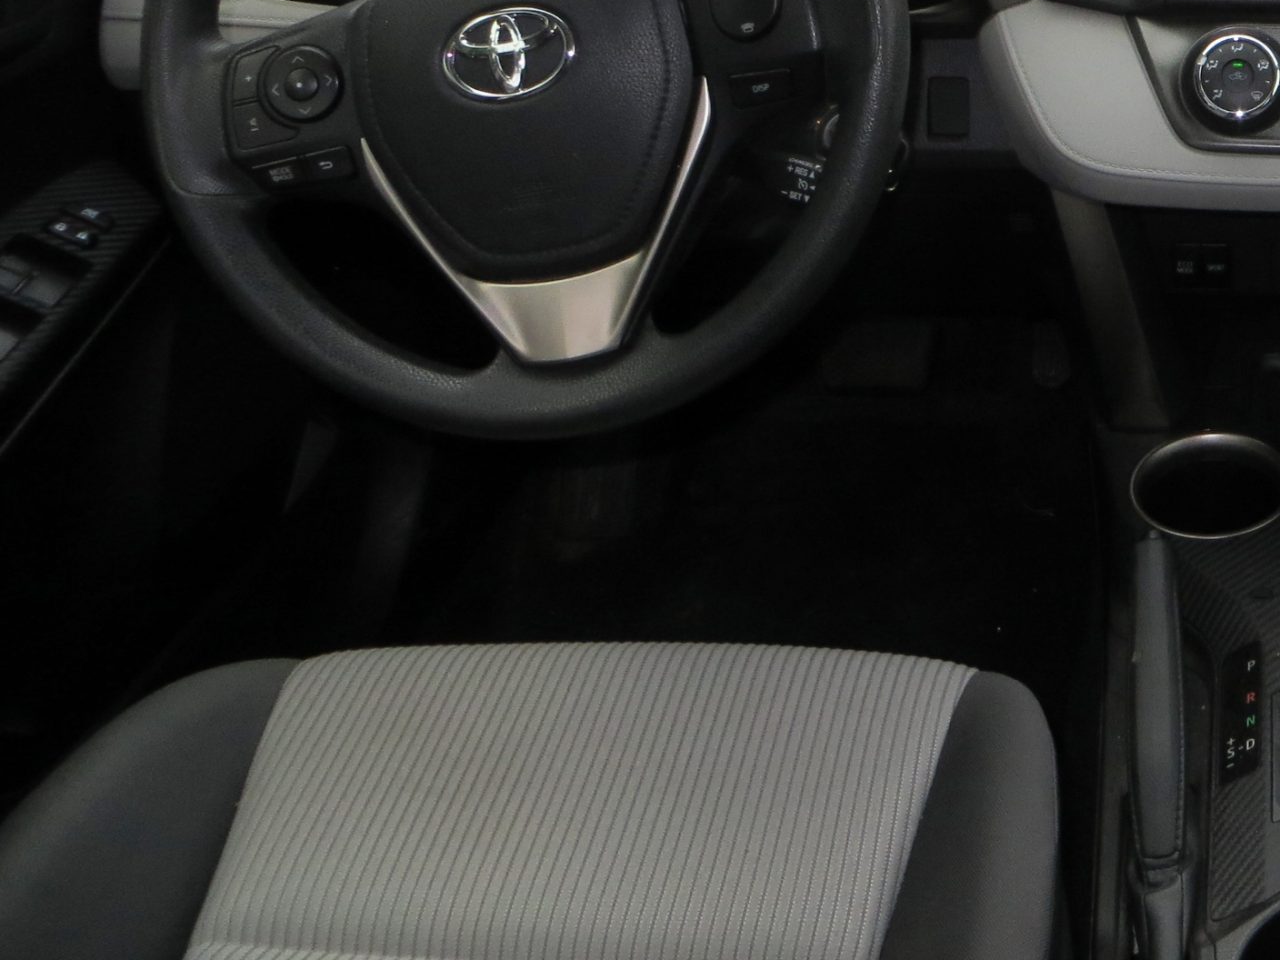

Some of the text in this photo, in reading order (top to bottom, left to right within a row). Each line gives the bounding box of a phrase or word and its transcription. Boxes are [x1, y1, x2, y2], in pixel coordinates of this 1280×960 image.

[752, 83, 770, 93] DISP
[1247, 660, 1256, 671] P
[1247, 692, 1256, 704] R
[1246, 714, 1256, 727] N
[1246, 738, 1255, 751] D
[1227, 747, 1235, 759] S
